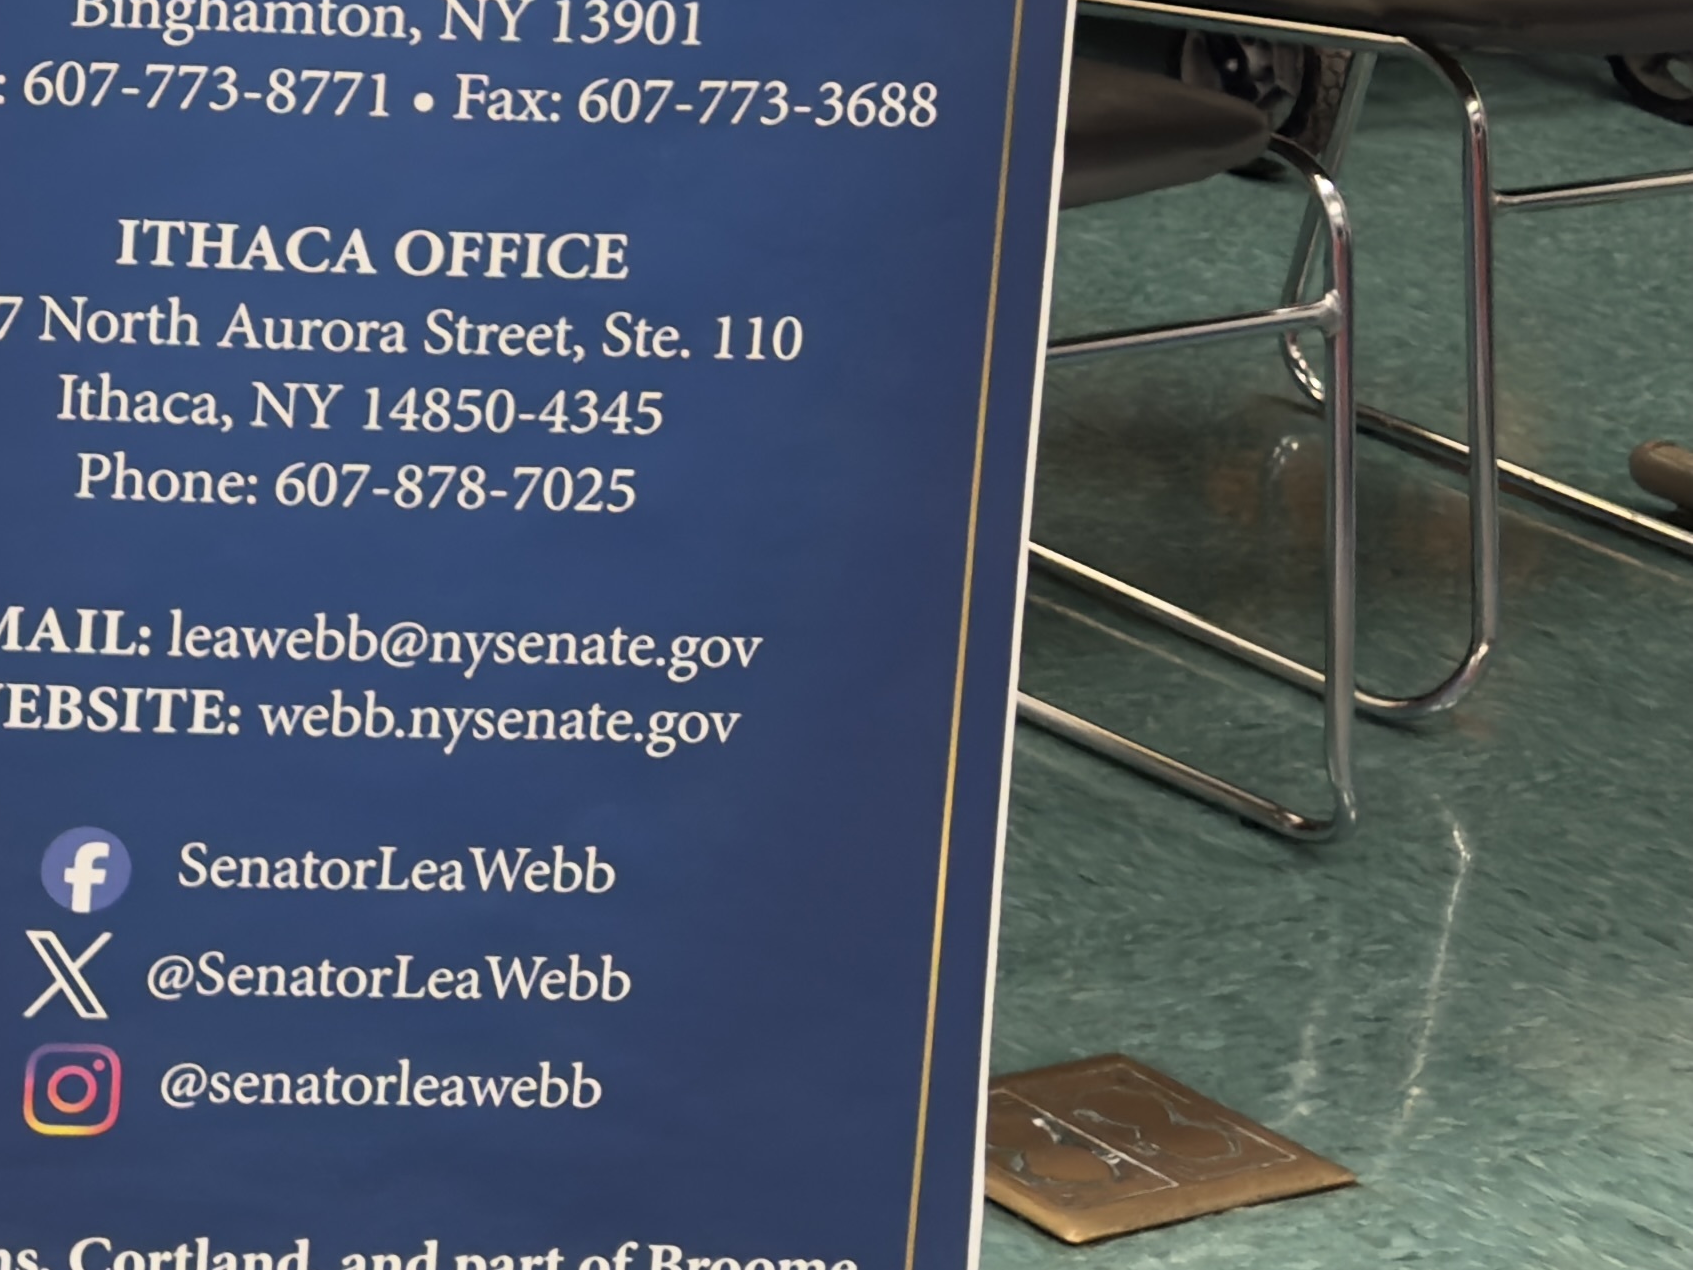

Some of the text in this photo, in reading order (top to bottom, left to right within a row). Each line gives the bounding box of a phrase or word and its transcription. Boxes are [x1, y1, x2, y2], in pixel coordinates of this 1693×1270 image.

[553, 0, 701, 45] 13901
[24, 61, 389, 116] 607-773-8771
[453, 74, 561, 122] Fax:
[579, 78, 937, 127] 607-773-3688
[116, 219, 628, 279] ITHACA OFFICE
[39, 296, 200, 346] North
[217, 303, 407, 353] Aurora
[424, 309, 585, 362] Street,
[603, 312, 689, 358] Ste.
[714, 316, 802, 360] 110
[57, 372, 662, 435] Ithaca, NY 14850-4345
[75, 451, 635, 512] Phone: 607-878-7025
[168, 609, 763, 682] leawebb@nysenate.gov
[258, 689, 741, 757] webb.nysenate.gov
[161, 1059, 601, 1108] @senatorleawebb
